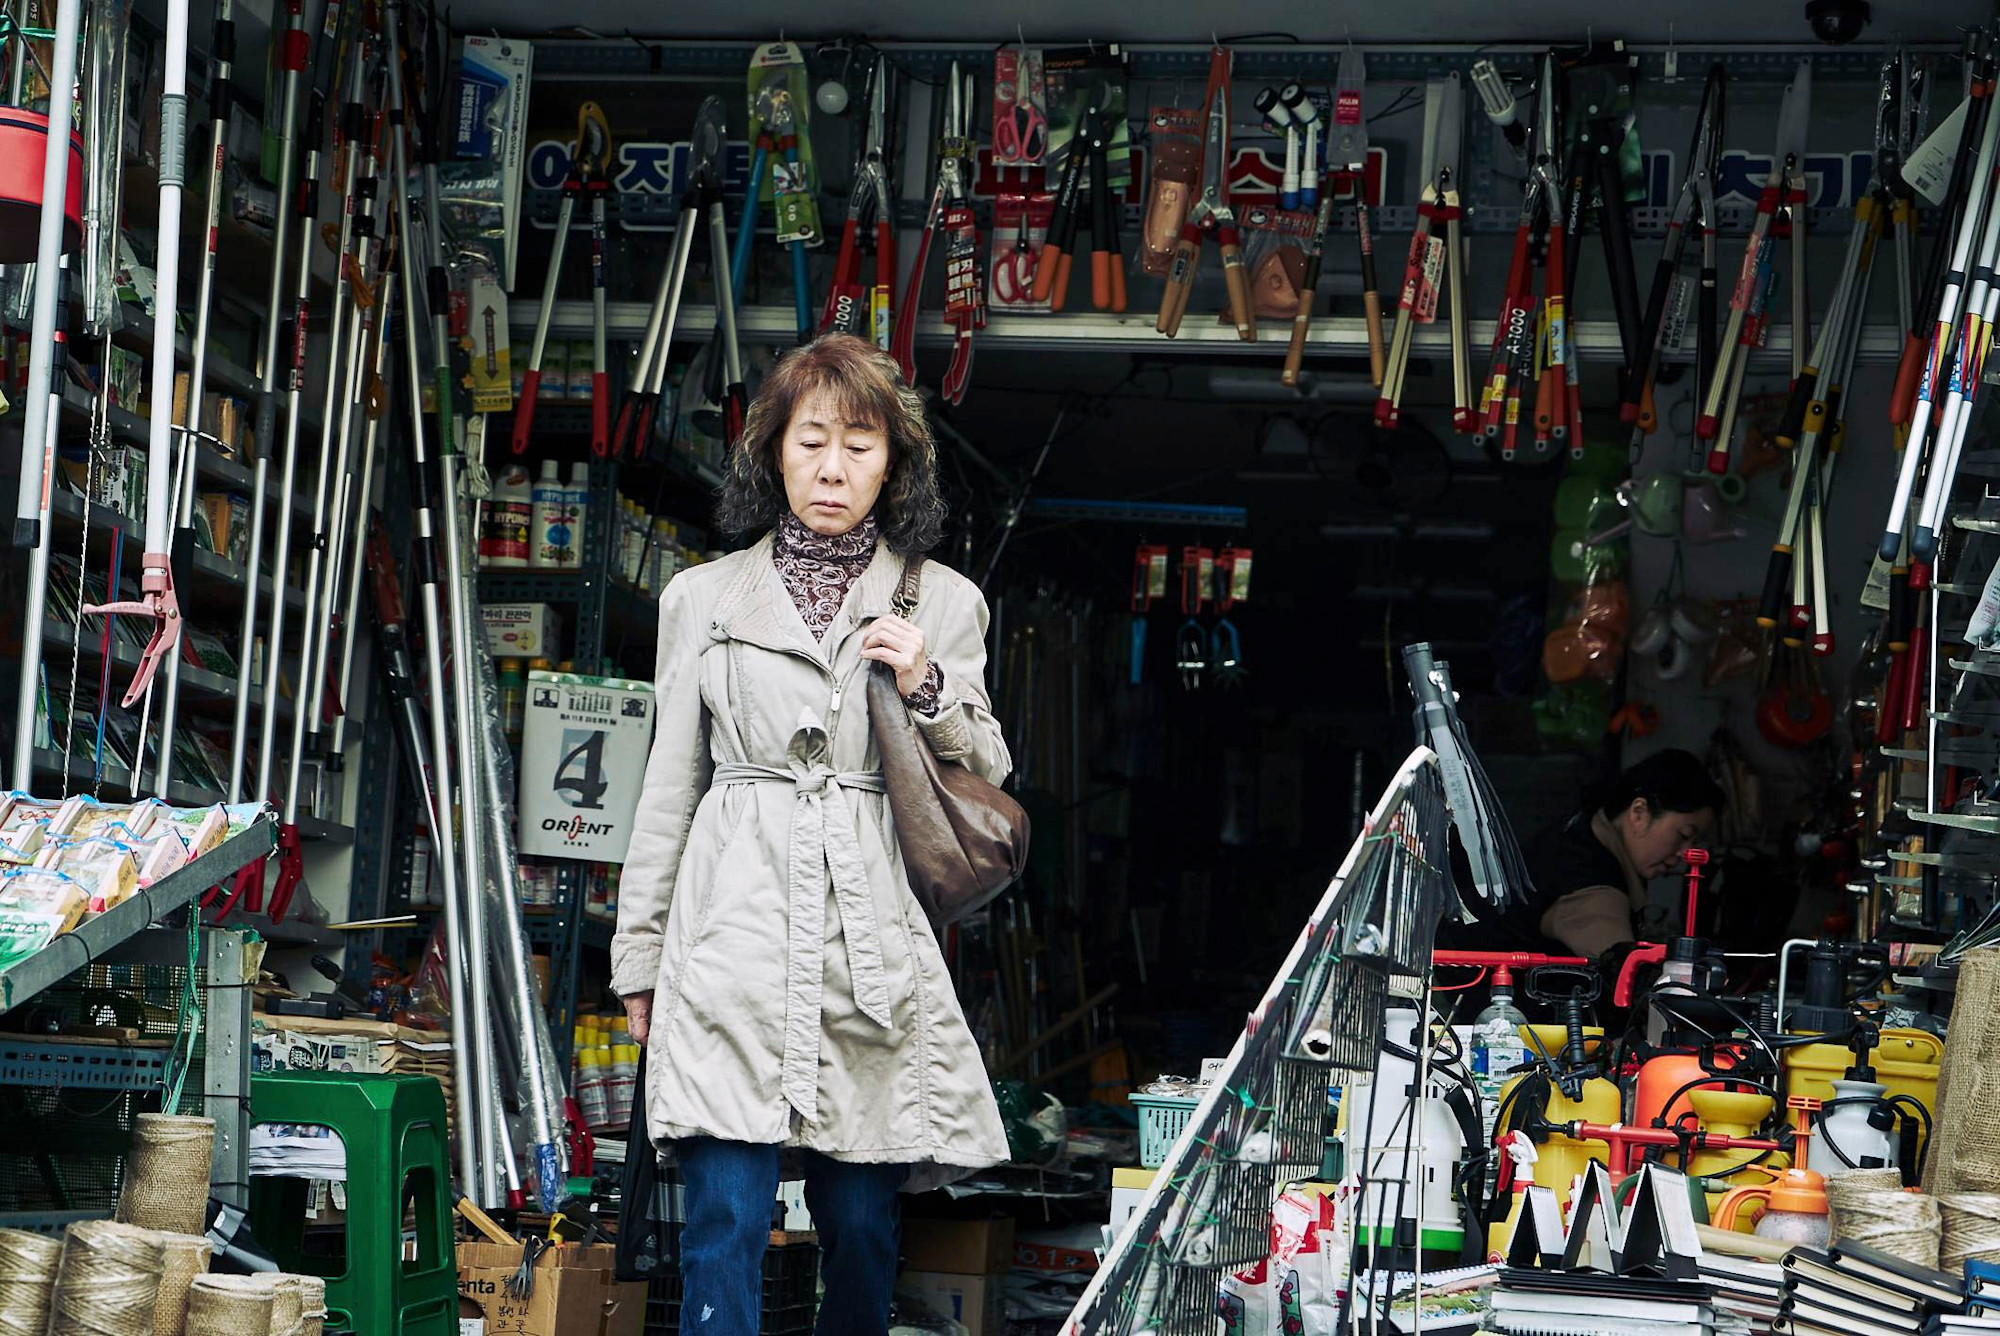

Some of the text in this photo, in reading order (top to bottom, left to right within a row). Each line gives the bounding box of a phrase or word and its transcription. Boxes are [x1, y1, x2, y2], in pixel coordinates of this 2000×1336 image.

[832, 295, 853, 334] -1000
[1506, 307, 1527, 355] A-1000
[553, 730, 608, 810] 4
[541, 815, 614, 839] ORIENT
